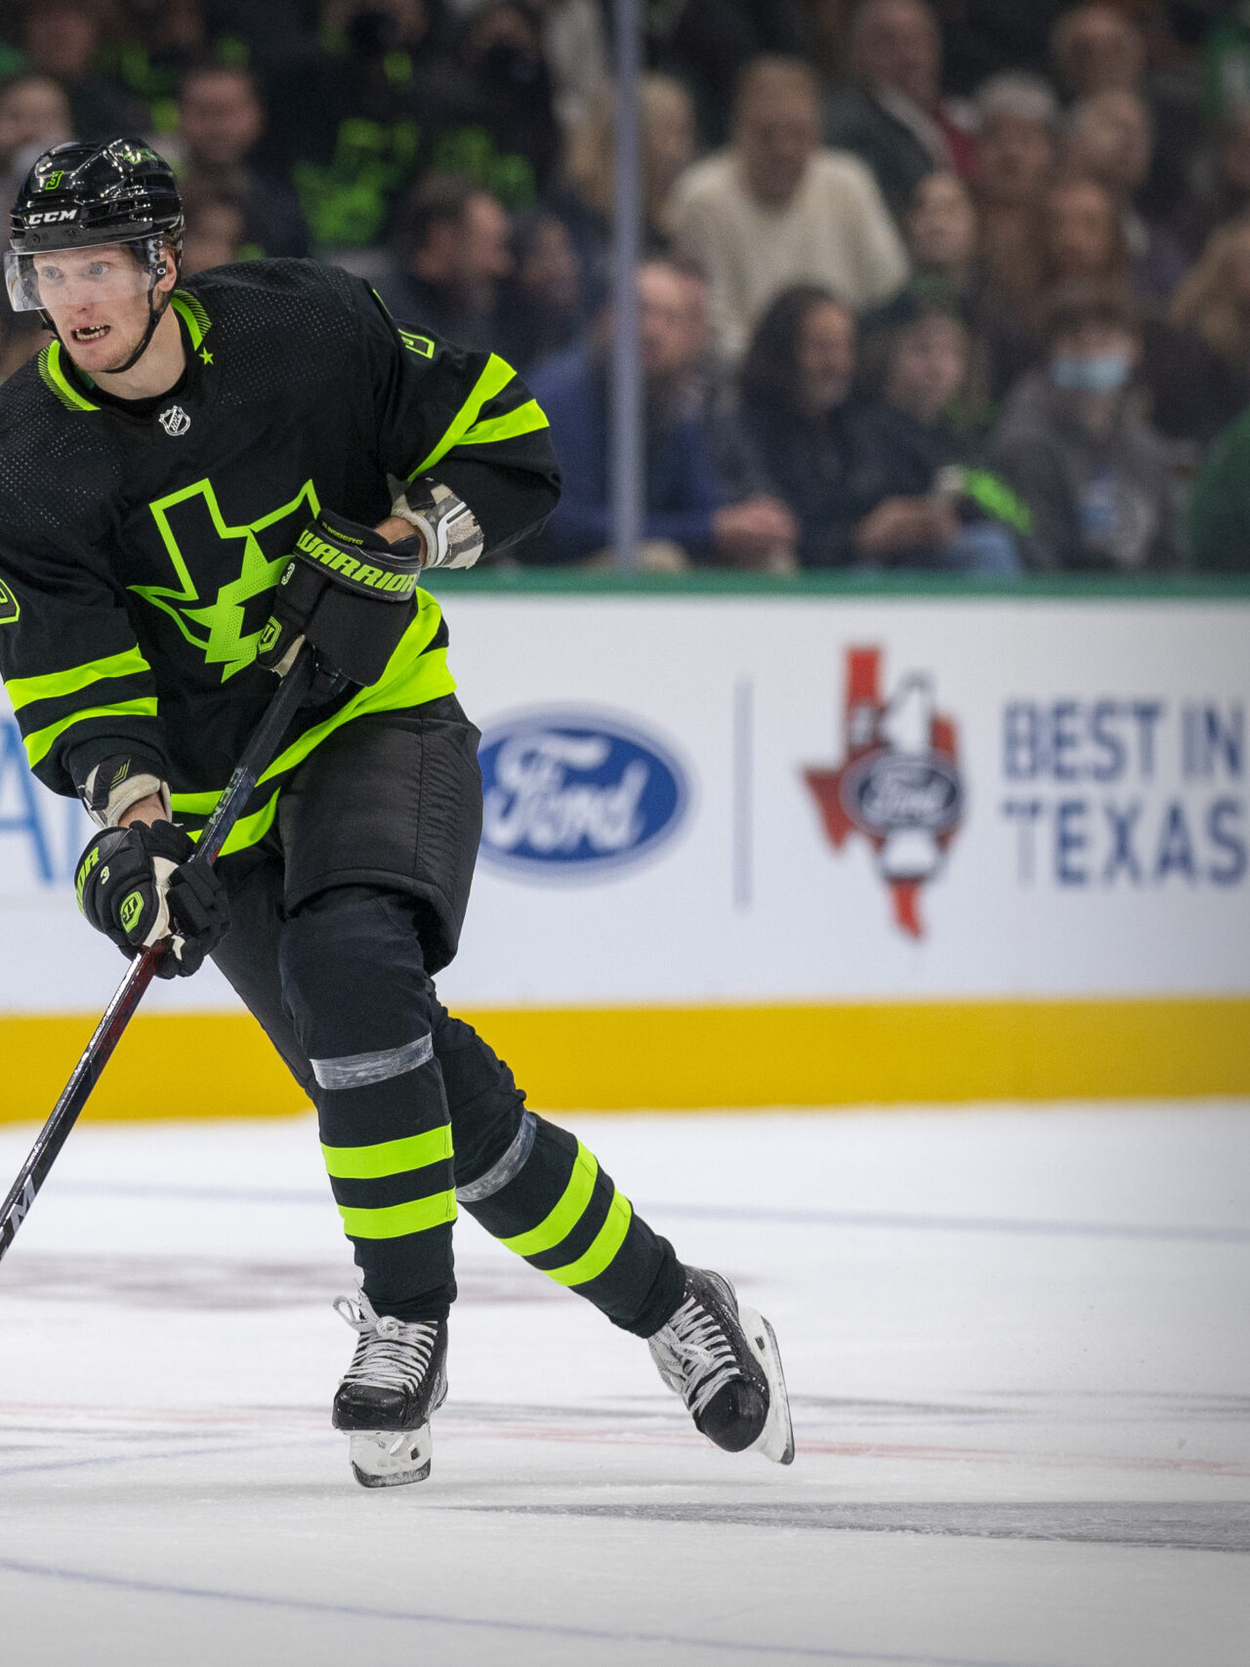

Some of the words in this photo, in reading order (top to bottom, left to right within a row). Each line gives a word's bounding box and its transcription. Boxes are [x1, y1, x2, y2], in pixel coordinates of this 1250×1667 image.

[45, 170, 65, 190] 3
[28, 209, 78, 226] CCM
[281, 562, 296, 586] 3
[296, 529, 418, 593] WARRIOR
[1002, 699, 1162, 783] BEST
[1180, 700, 1246, 783] IN
[485, 733, 649, 852] Ford
[1001, 798, 1248, 887] TEXAS
[99, 864, 111, 886] 3
